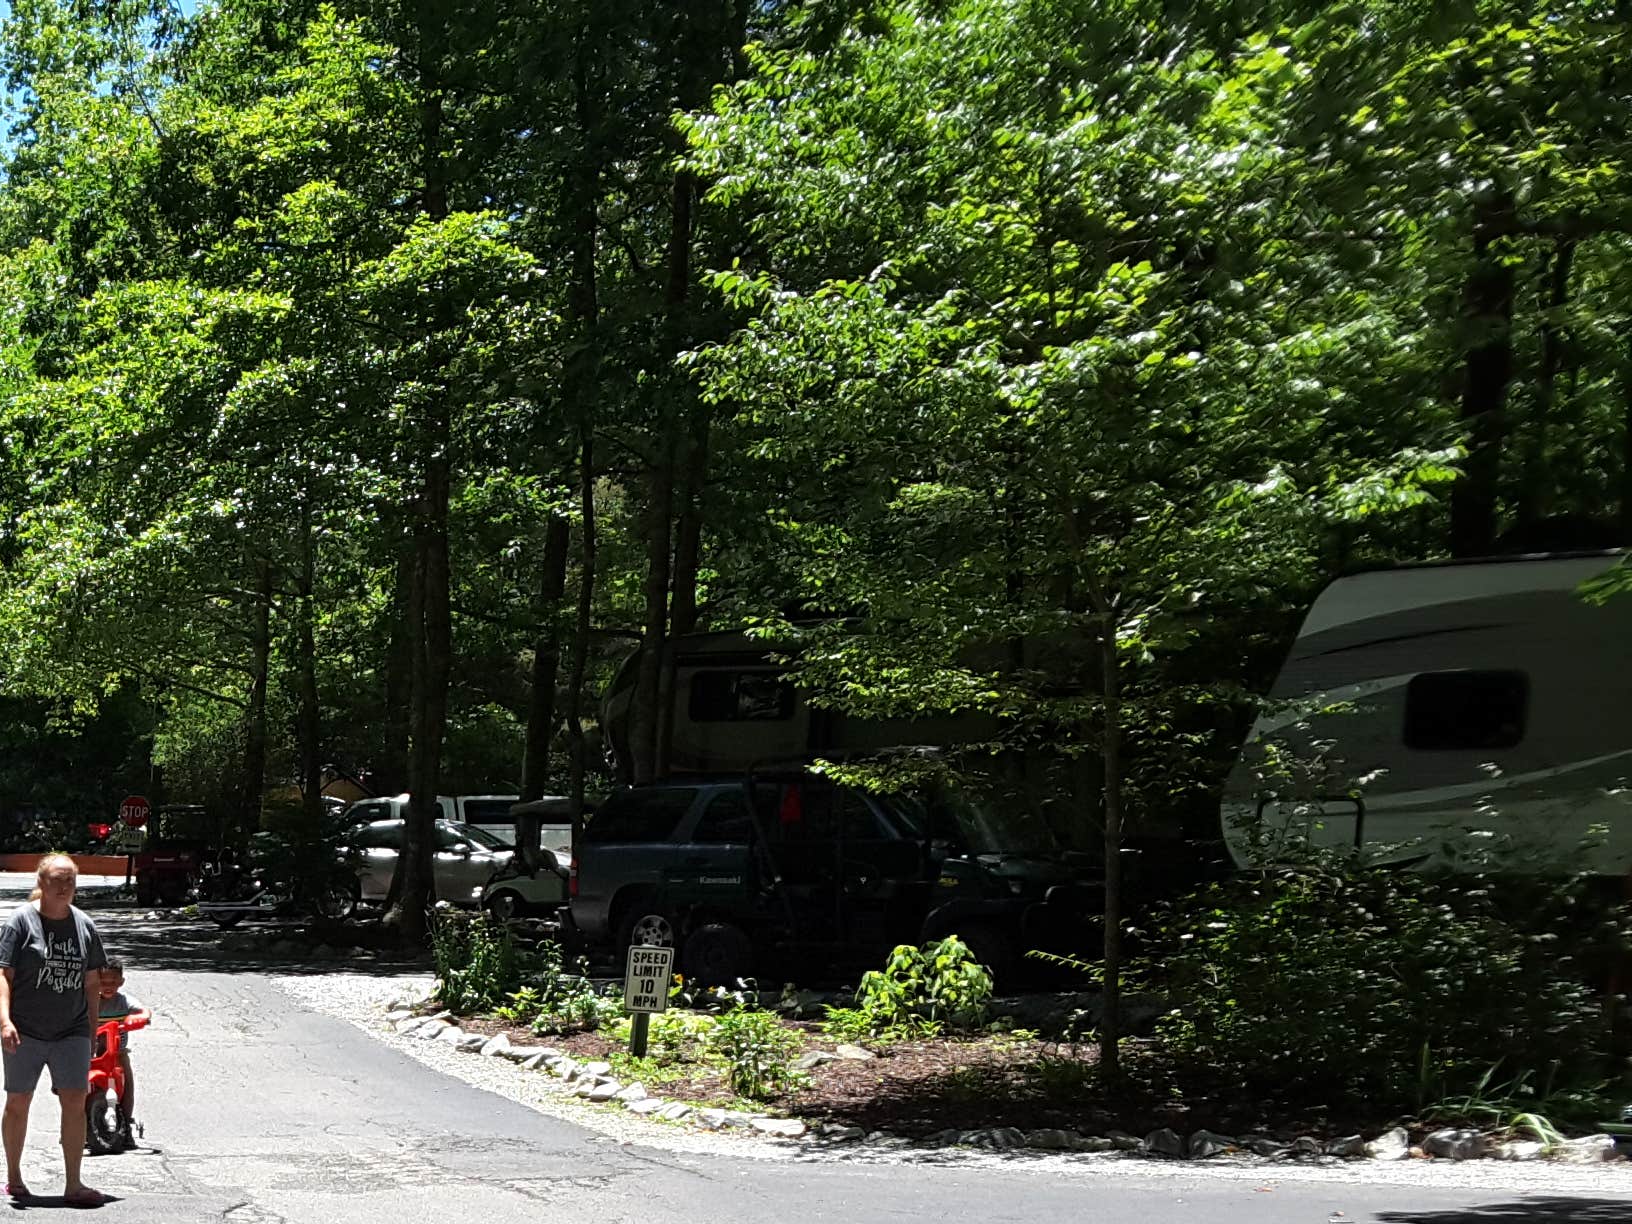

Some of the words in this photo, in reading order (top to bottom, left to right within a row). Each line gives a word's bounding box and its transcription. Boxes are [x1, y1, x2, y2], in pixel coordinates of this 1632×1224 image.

[122, 805, 148, 817] STOP
[633, 952, 667, 964] SPEED
[633, 965, 665, 978] LIMIT
[640, 979, 655, 994] 10
[632, 995, 658, 1008] MPH
